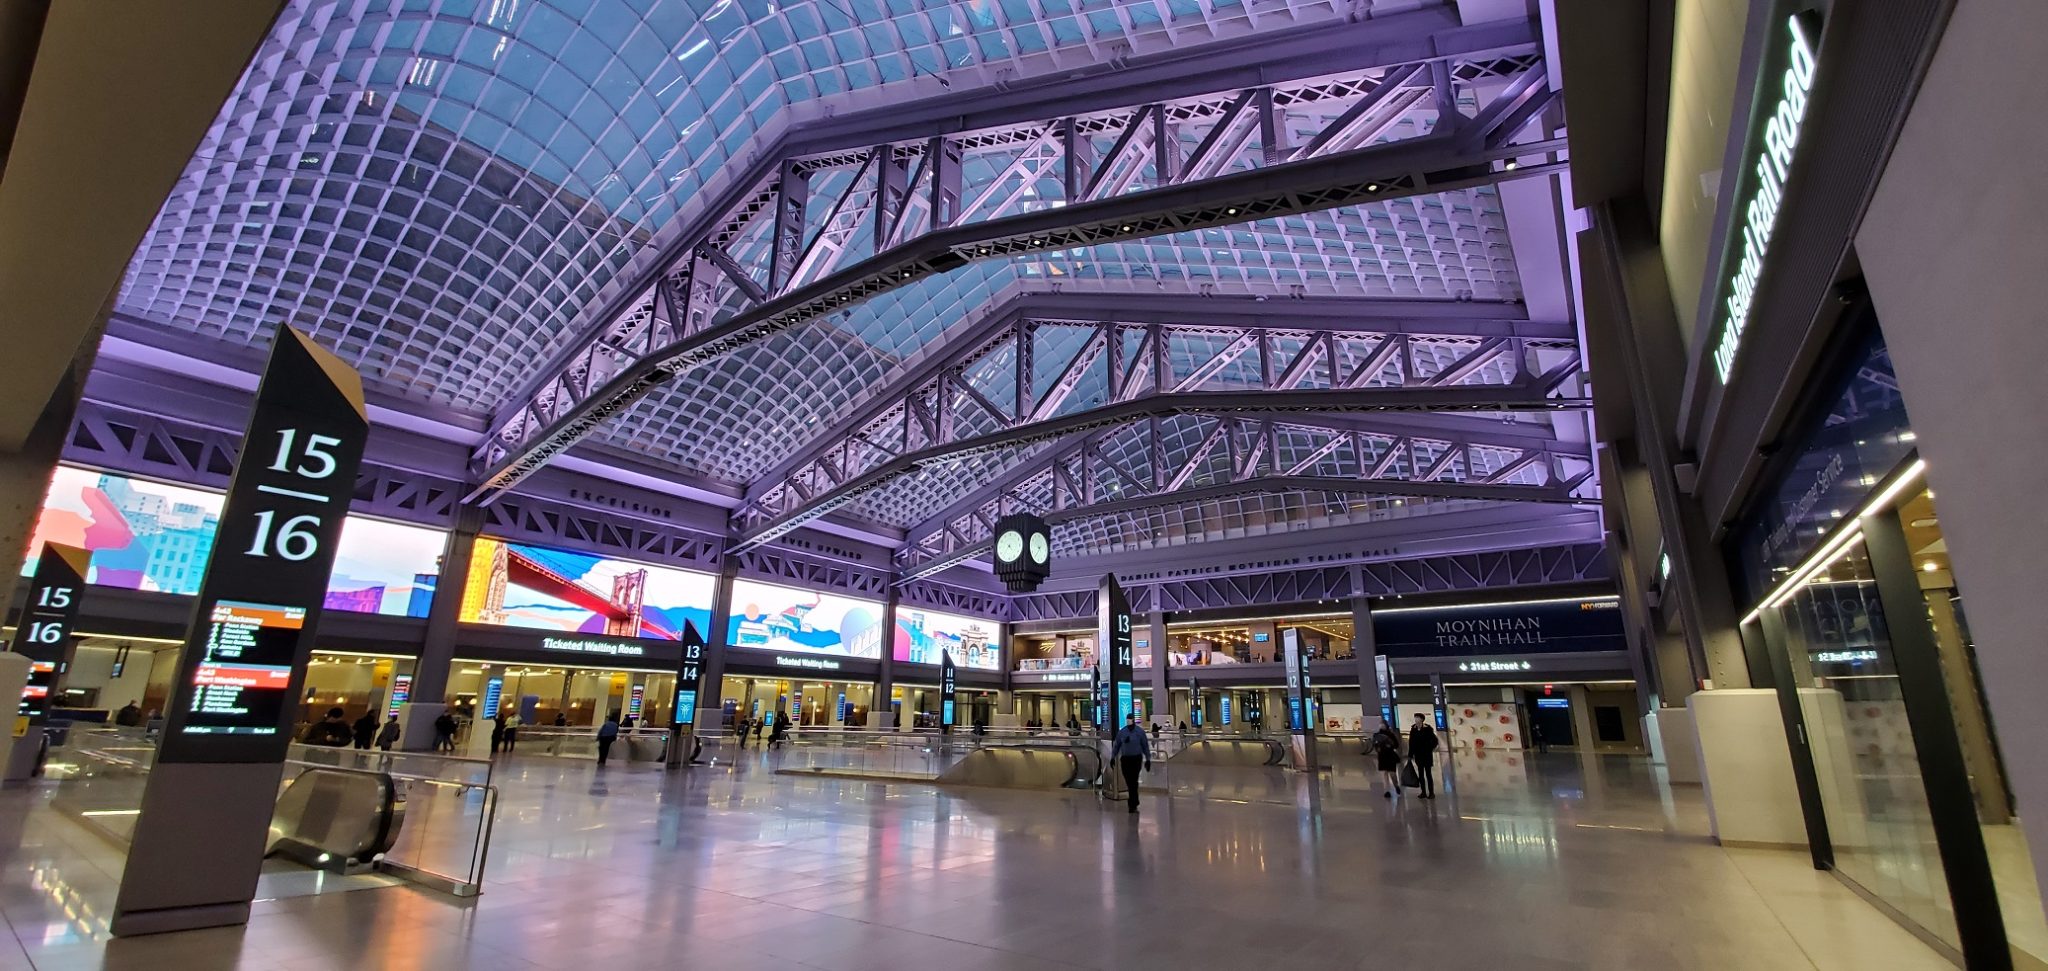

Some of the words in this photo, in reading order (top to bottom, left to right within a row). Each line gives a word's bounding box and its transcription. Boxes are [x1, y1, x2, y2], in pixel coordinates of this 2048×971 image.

[1727, 226, 1760, 335] Island
[1748, 153, 1781, 256] Rail
[1766, 15, 1815, 183] Road
[267, 428, 341, 478] 15
[1816, 453, 1843, 494] Service
[570, 489, 671, 518] EXCELSIOR
[244, 510, 321, 561] 16
[781, 536, 811, 549] EVER
[817, 544, 862, 560] UPWARD
[1308, 552, 1353, 563] TRAIN
[1362, 547, 1399, 558] HALL
[38, 586, 72, 608] 15
[27, 621, 62, 643] 16
[1118, 614, 1130, 633] 13
[1436, 616, 1541, 634] MOYNIHAN
[543, 637, 582, 650] Ticketed
[585, 641, 617, 654] Waiting
[618, 643, 642, 655] Room
[1436, 633, 1491, 647] TRAIN
[1498, 631, 1547, 645] HALL
[686, 645, 700, 659] 13
[1118, 646, 1130, 666] 14
[776, 656, 801, 666] Ticketed
[802, 658, 823, 669] Waiting
[823, 660, 839, 669] Room
[1470, 662, 1490, 671] 31st
[1490, 661, 1519, 671] Street
[683, 667, 697, 680] 14
[947, 668, 953, 678] 11
[1290, 675, 1297, 688] 12
[1380, 674, 1385, 683] 9
[946, 683, 954, 693] 12
[1381, 688, 1388, 699] 10
[1433, 685, 1438, 693] 7
